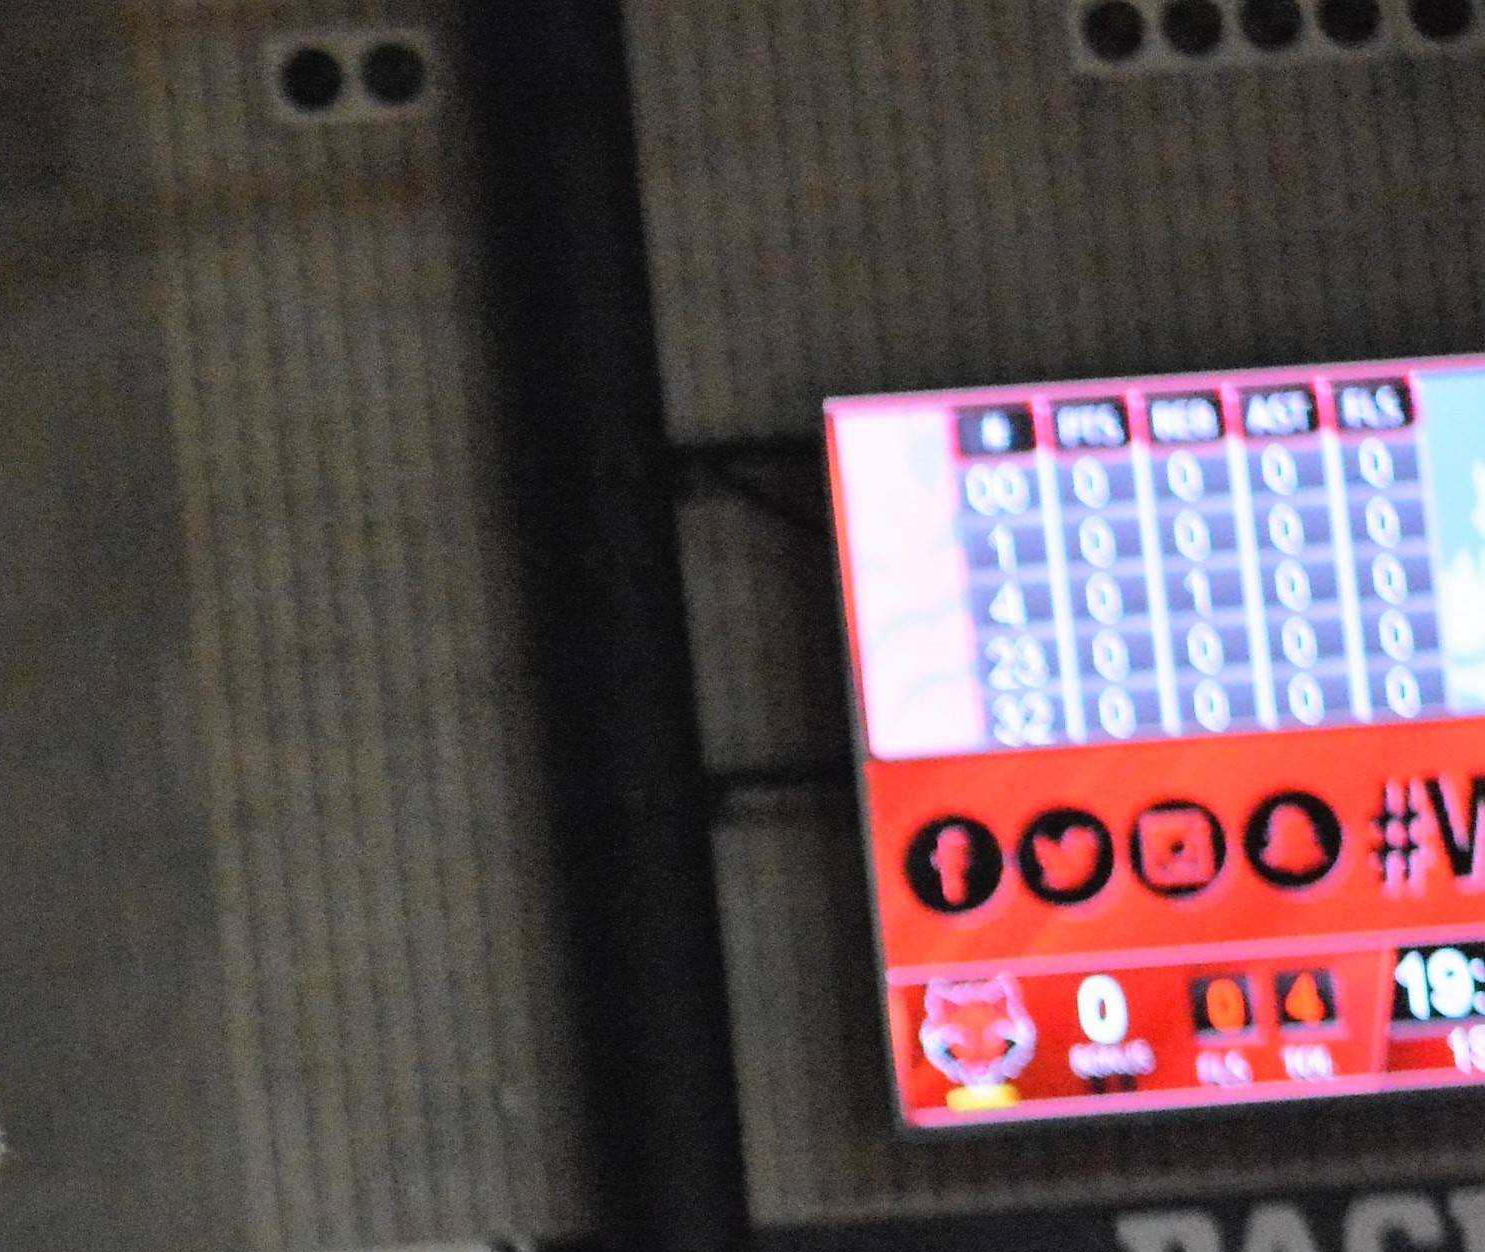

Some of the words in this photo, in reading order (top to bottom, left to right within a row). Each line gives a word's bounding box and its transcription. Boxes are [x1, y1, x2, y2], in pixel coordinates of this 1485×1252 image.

[1246, 390, 1311, 436] AST
[966, 463, 1029, 515] 00
[1072, 455, 1110, 509] 0
[1167, 450, 1204, 502] 0
[1262, 443, 1298, 496] 0
[1358, 437, 1394, 489] 0
[988, 523, 1017, 574] 1
[1080, 514, 1117, 568] 0
[1174, 509, 1211, 562] 0
[1268, 503, 1304, 556] 0
[1366, 496, 1401, 549] 0
[989, 580, 1028, 627] 4
[1086, 571, 1123, 625] 0
[1183, 567, 1213, 618] 1
[1275, 559, 1311, 613] 0
[1372, 553, 1408, 605] 0
[1091, 628, 1130, 682] 0
[1187, 622, 1224, 676] 0
[1282, 615, 1318, 670] 0
[1378, 608, 1415, 662] 0
[1098, 685, 1137, 740] 0
[1193, 678, 1231, 733] 0
[1287, 671, 1325, 726] 0
[1385, 664, 1422, 719] 0
[1077, 974, 1128, 1044] 0
[1205, 977, 1246, 1033] 0
[1284, 970, 1326, 1026] 4
